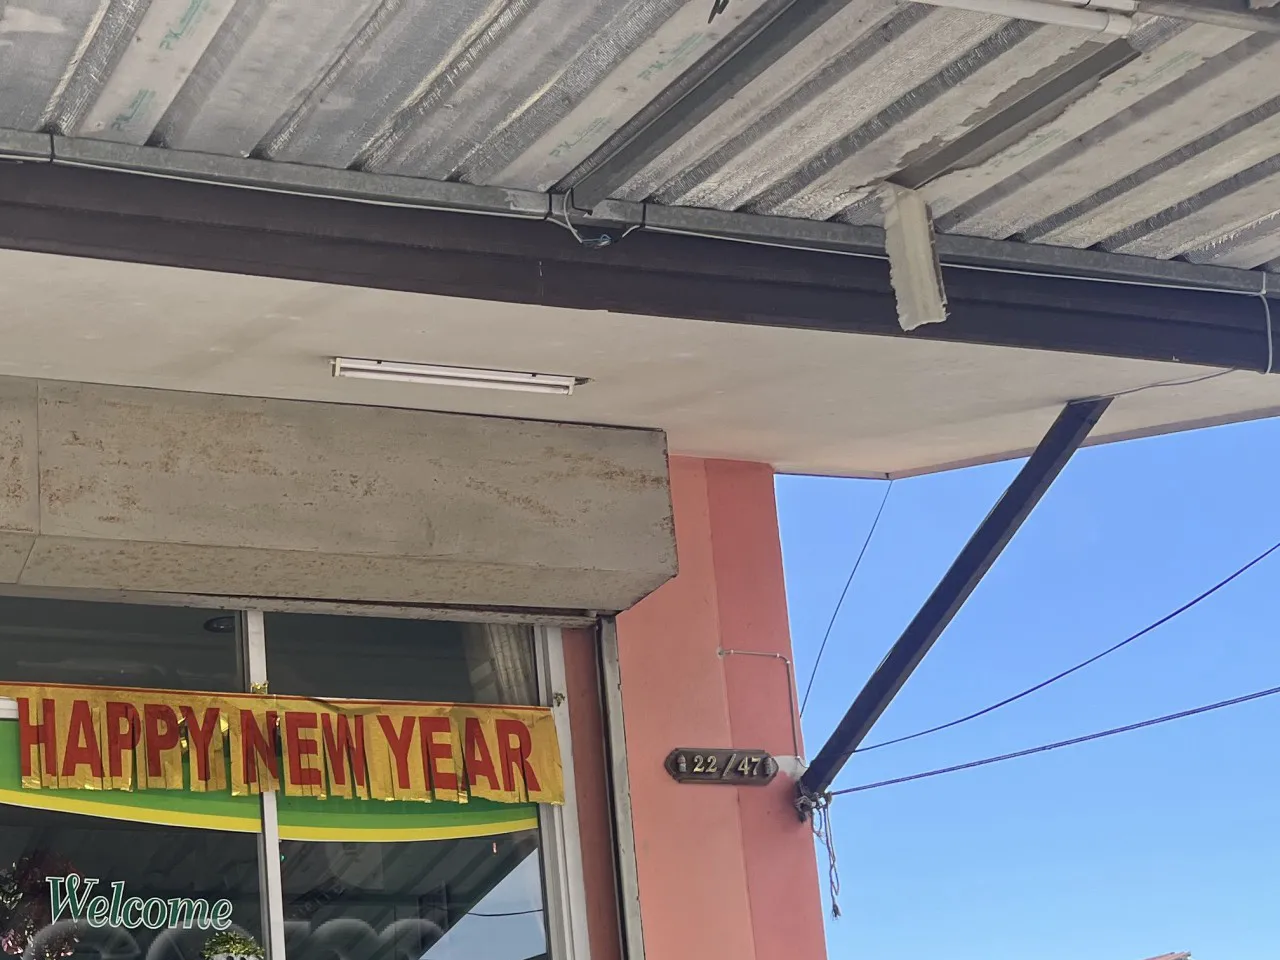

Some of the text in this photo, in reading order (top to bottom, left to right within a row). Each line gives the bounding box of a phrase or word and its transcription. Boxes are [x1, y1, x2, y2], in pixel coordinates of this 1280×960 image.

[17, 698, 542, 792] HAPPY NEW YEAR
[45, 873, 234, 930] Welcome
